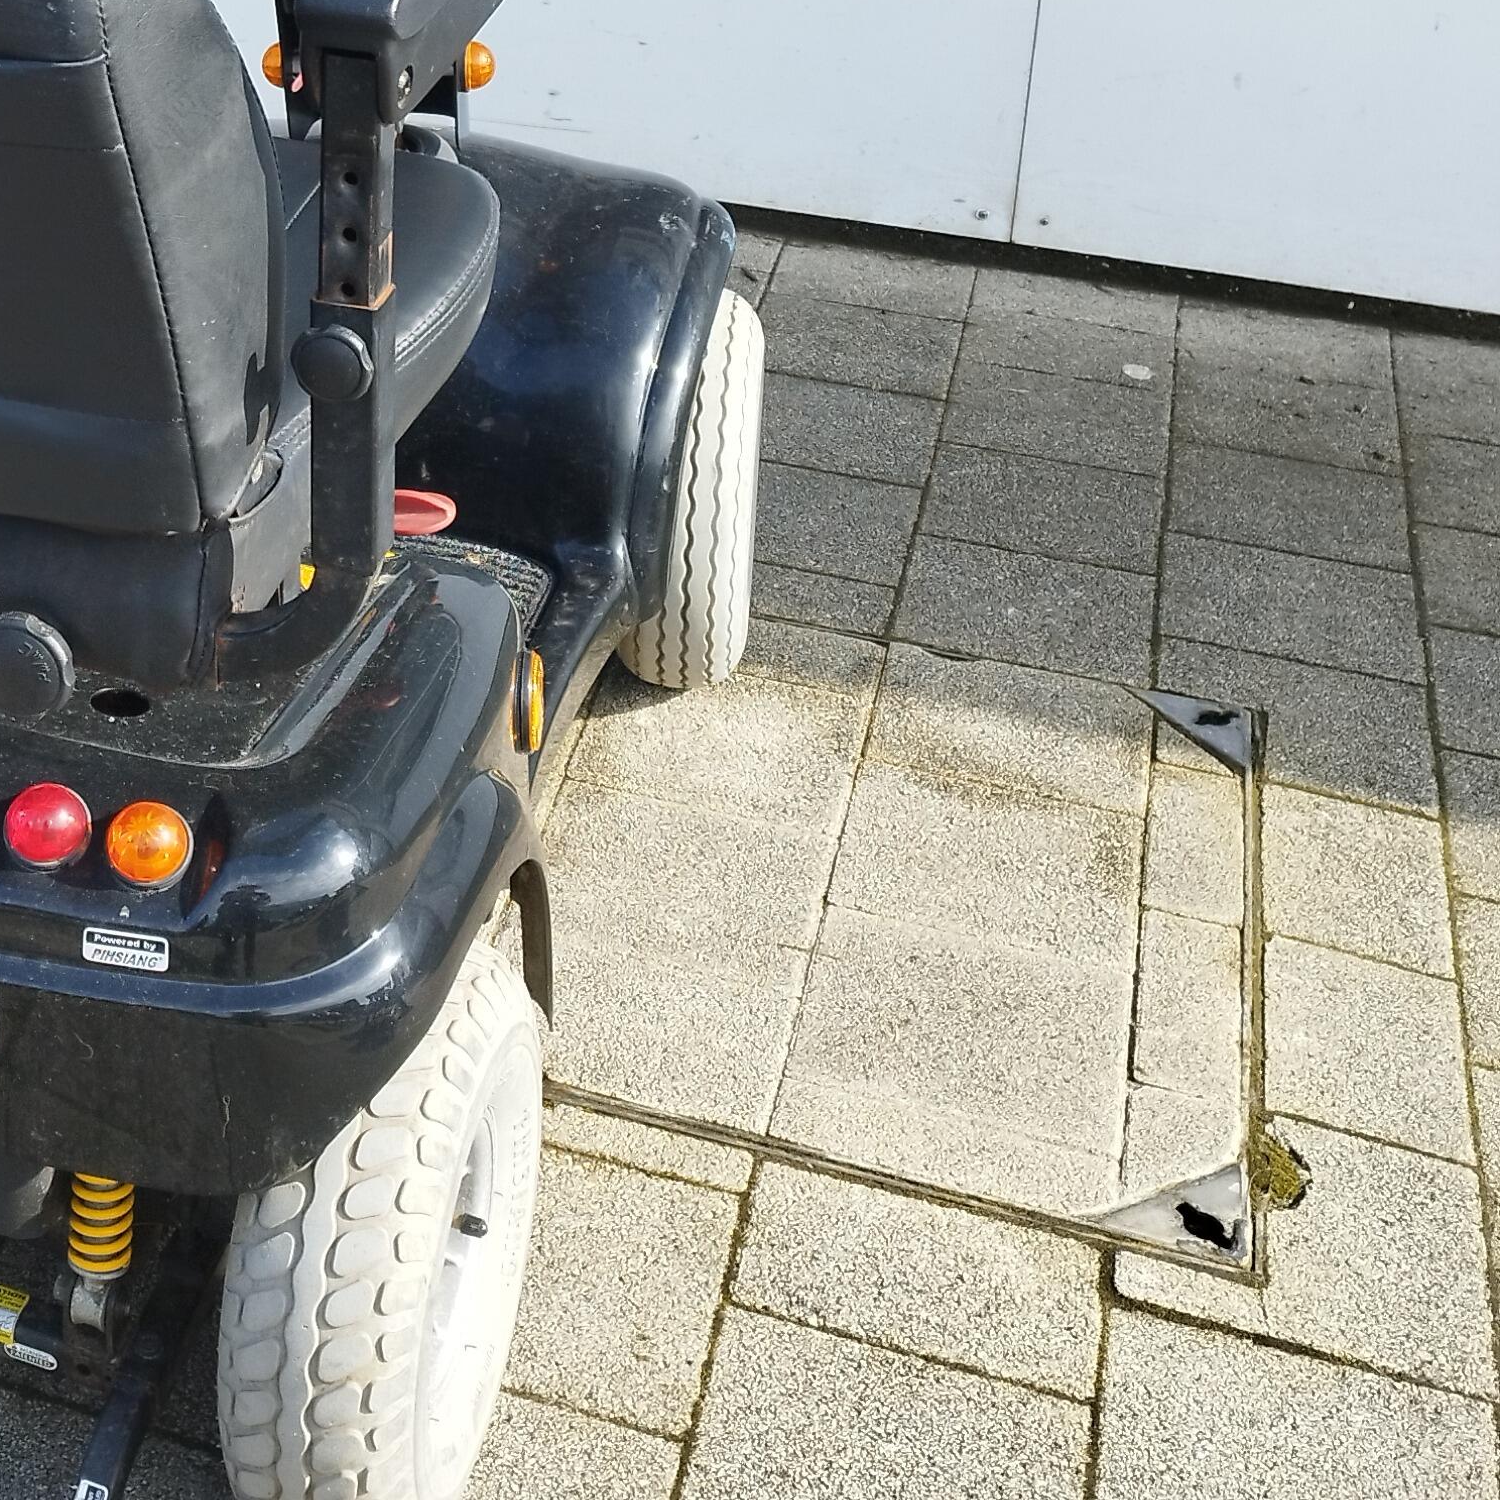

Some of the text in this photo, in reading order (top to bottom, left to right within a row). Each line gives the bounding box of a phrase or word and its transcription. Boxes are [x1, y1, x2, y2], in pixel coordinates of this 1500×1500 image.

[94, 933, 157, 952] Powered by
[91, 948, 158, 968] PIHSIANG
